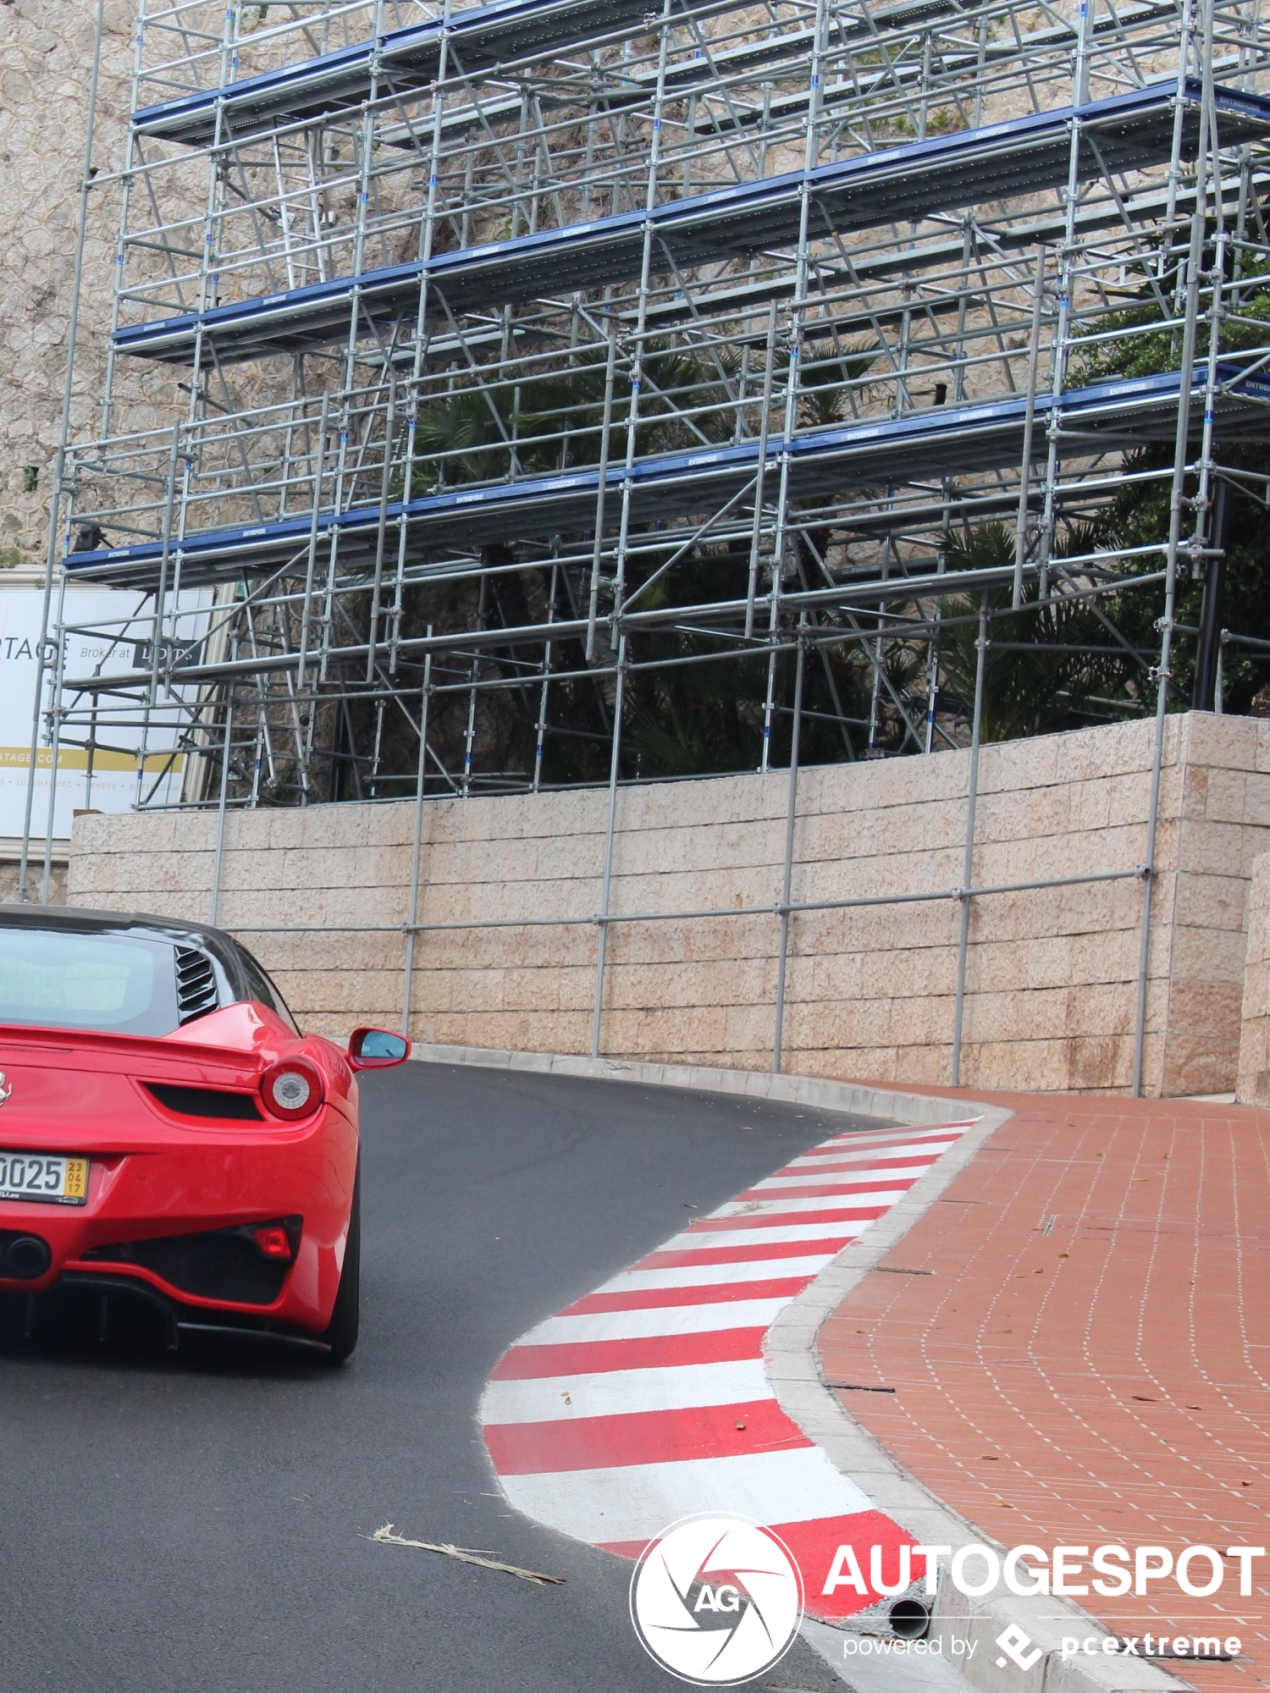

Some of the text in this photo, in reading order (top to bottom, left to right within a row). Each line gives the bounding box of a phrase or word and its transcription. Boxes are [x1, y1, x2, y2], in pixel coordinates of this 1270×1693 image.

[118, 648, 131, 658] at
[68, 1162, 82, 1172] 23
[68, 1172, 81, 1182] 04
[68, 1183, 81, 1193] 17
